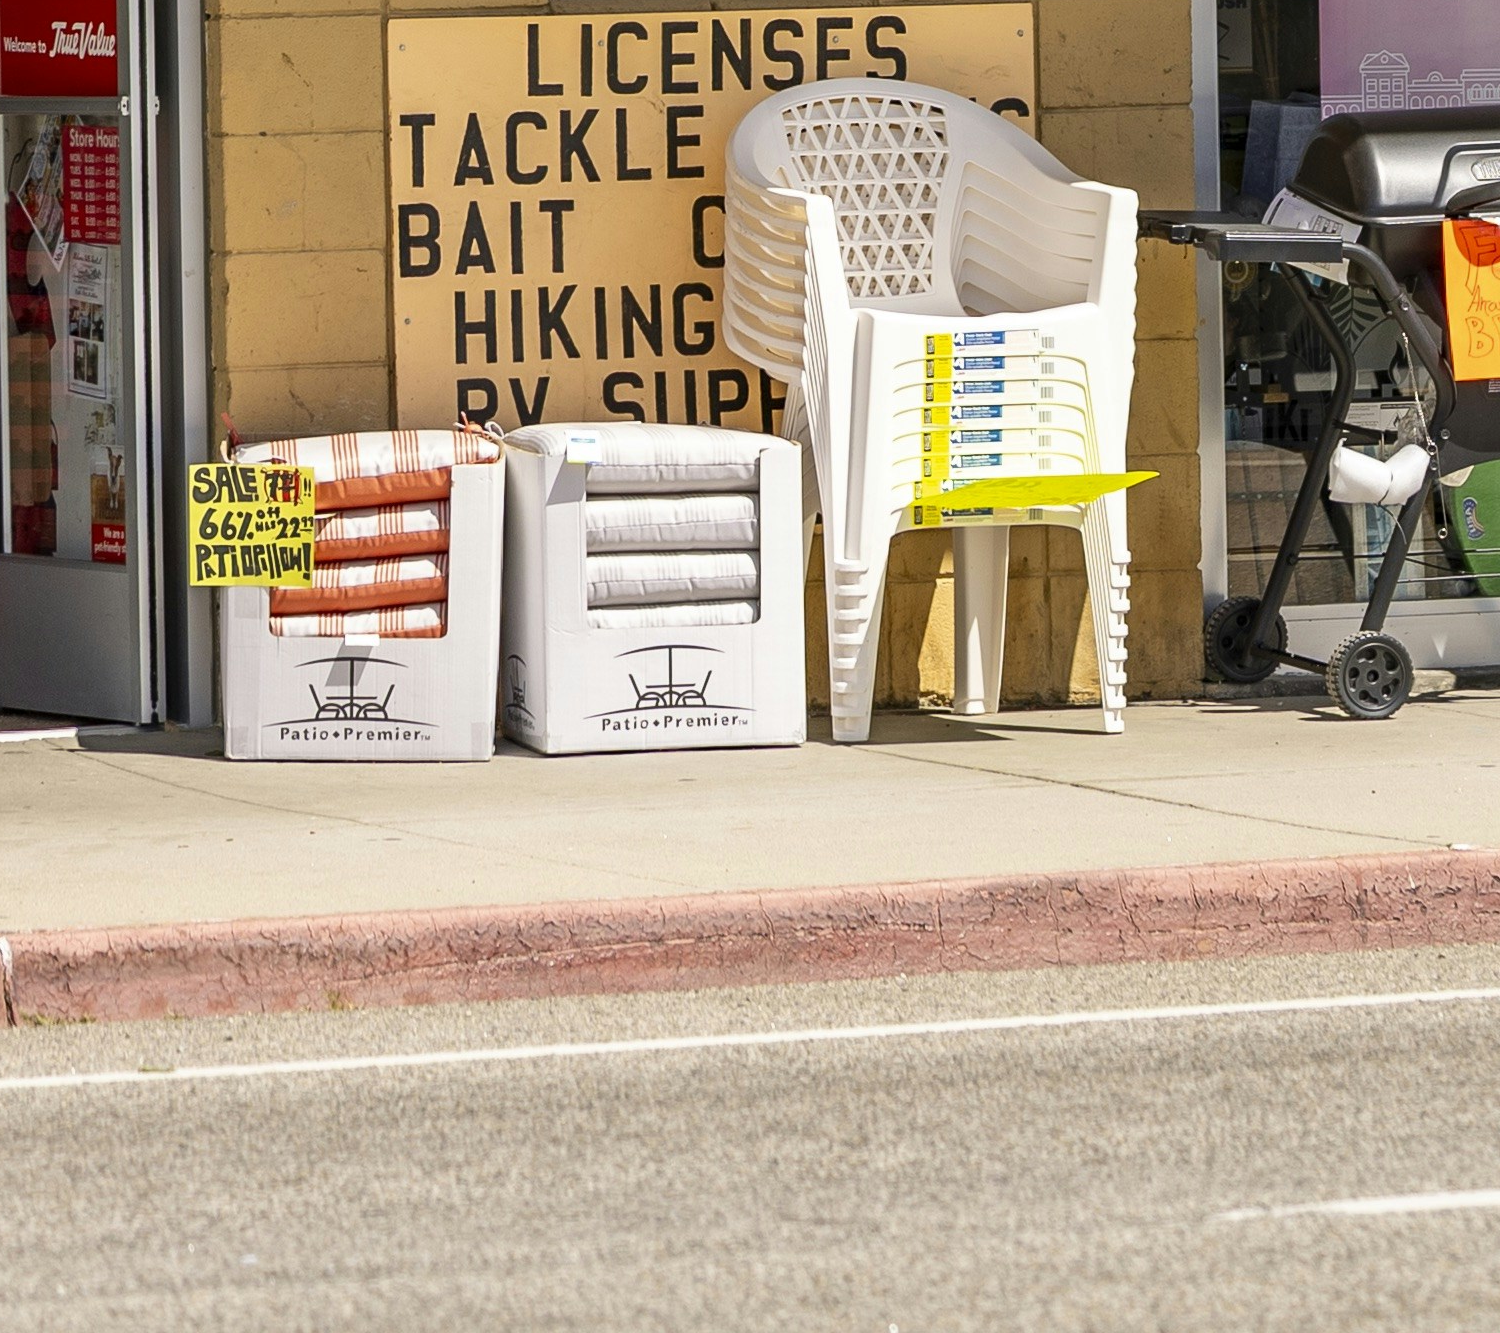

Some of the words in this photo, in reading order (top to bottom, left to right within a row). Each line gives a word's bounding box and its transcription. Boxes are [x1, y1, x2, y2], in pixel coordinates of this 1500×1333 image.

[3, 36, 37, 53] Welcome
[37, 38, 47, 54] to
[526, 15, 907, 97] LICENSES
[69, 128, 94, 147] Store
[398, 108, 702, 187] TACKLE
[398, 199, 575, 278] BAIT
[454, 284, 715, 363] HIKING
[103, 526, 112, 537] We
[198, 507, 254, 541] 66%
[279, 726, 329, 742] Patio
[344, 726, 422, 742] Premier
[600, 716, 649, 732] Patio
[663, 713, 740, 730] Premier
